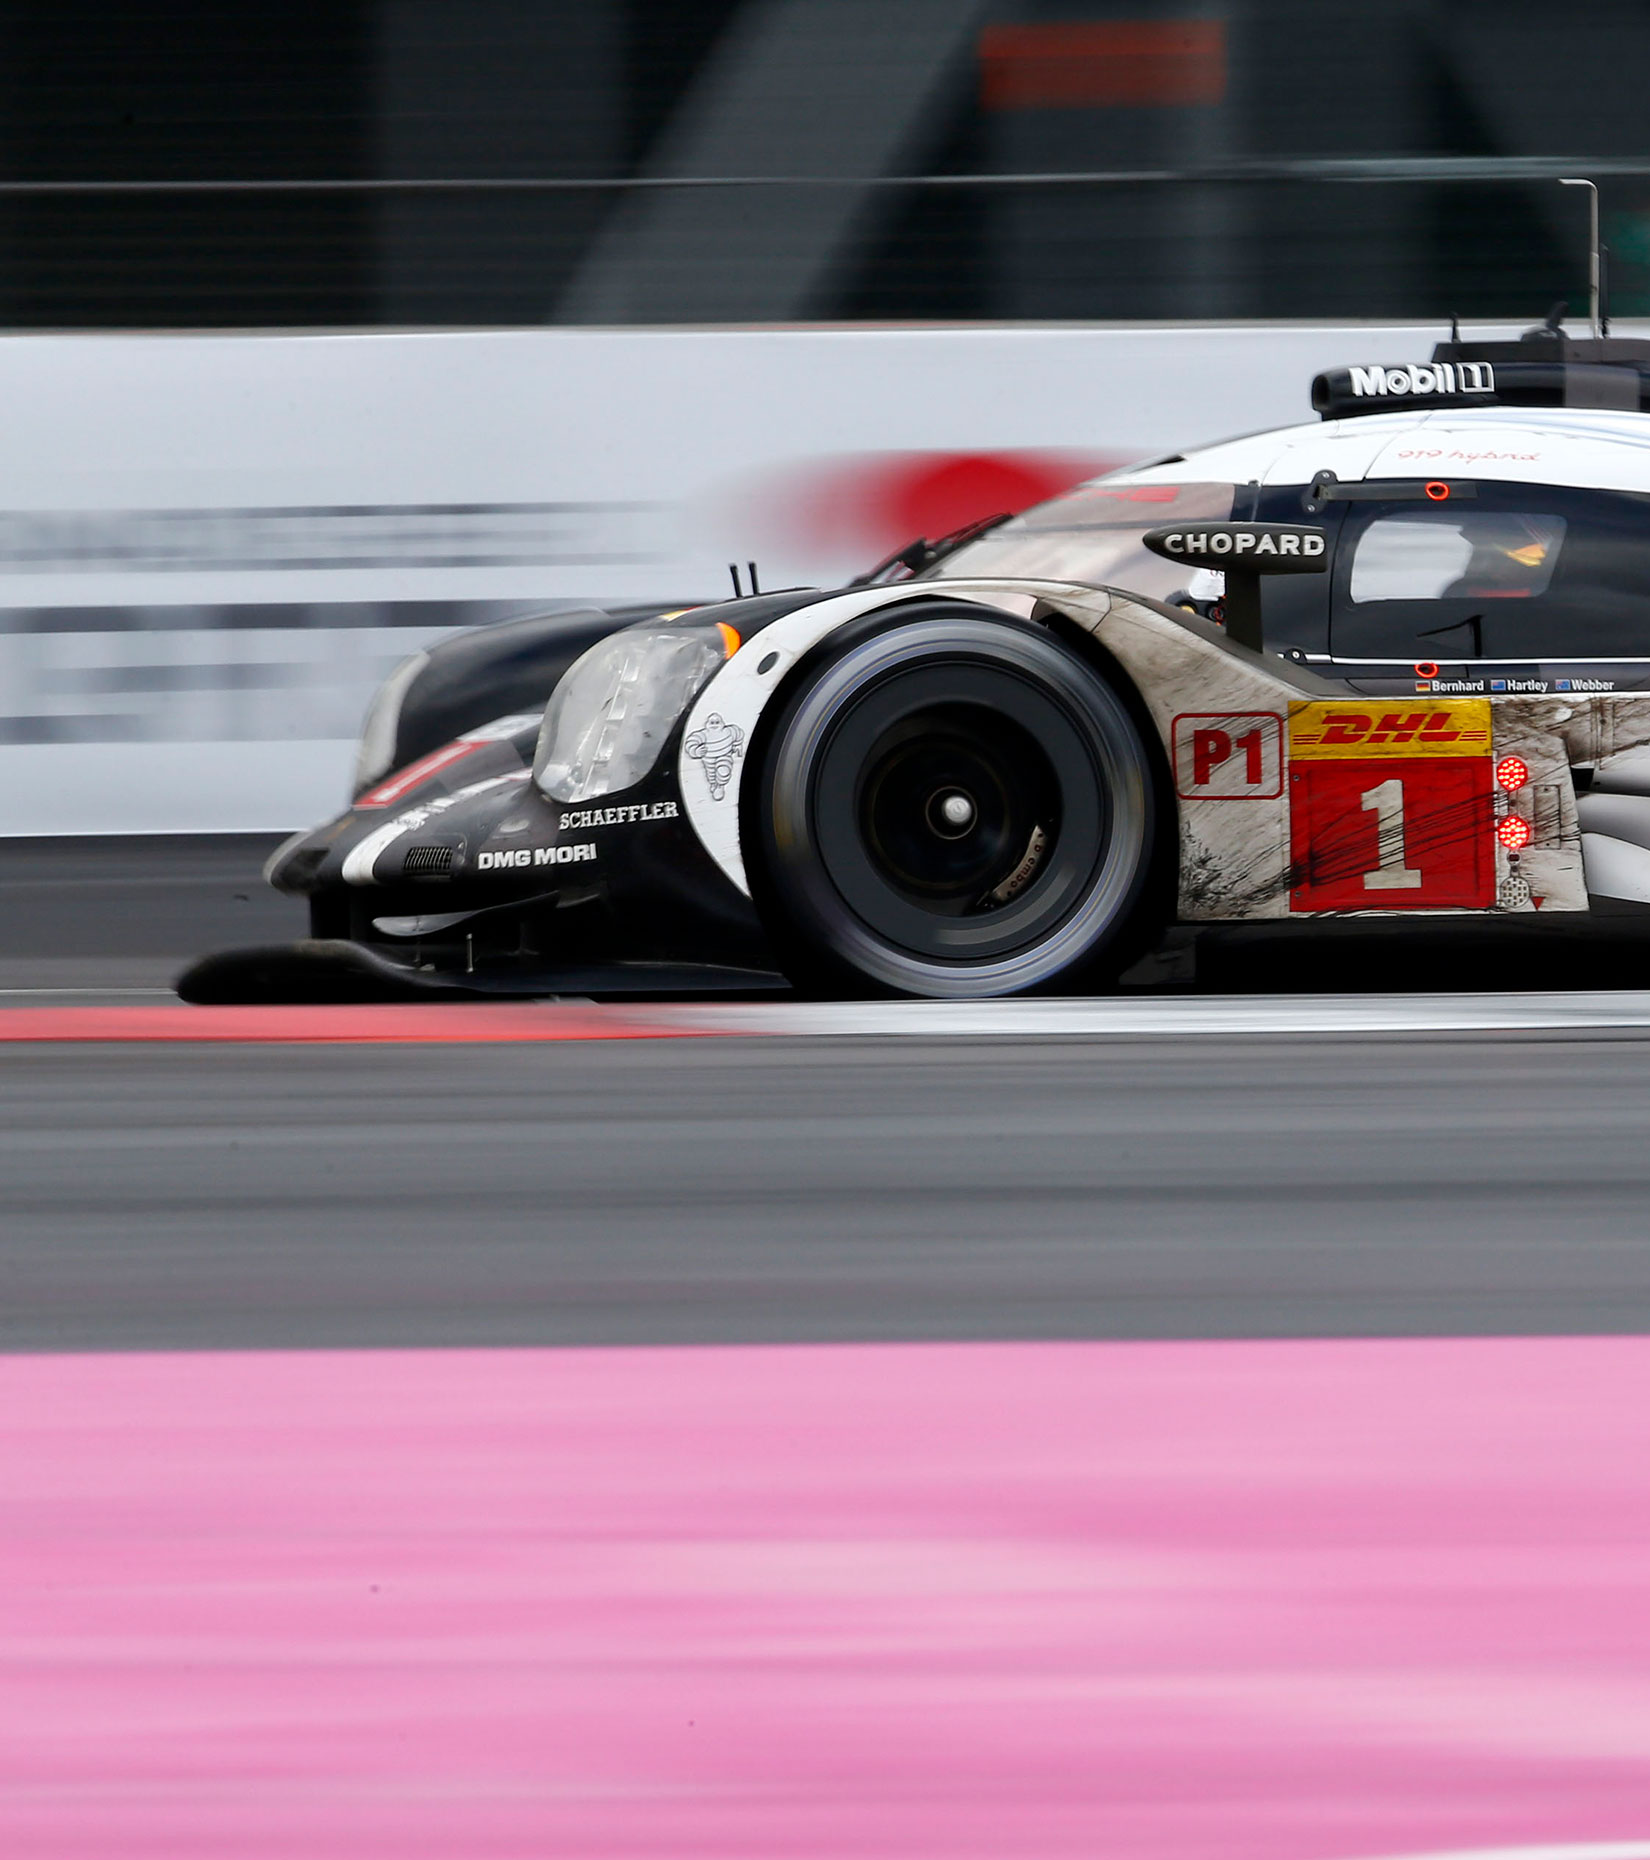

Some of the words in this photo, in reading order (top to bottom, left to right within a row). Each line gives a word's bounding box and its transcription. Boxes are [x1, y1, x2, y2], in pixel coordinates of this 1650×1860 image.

[1349, 362, 1456, 397] Mobil
[1164, 532, 1325, 556] CHOPARD
[1432, 680, 1484, 691] Bernhard
[1507, 679, 1548, 692] Hartley
[1571, 679, 1615, 690] Webber
[1319, 712, 1463, 745] DHL
[1193, 728, 1263, 785] P1
[558, 801, 680, 831] SCHAEFFLER
[1360, 779, 1422, 890] 1
[478, 851, 533, 870] DMG
[534, 842, 597, 866] MORI
